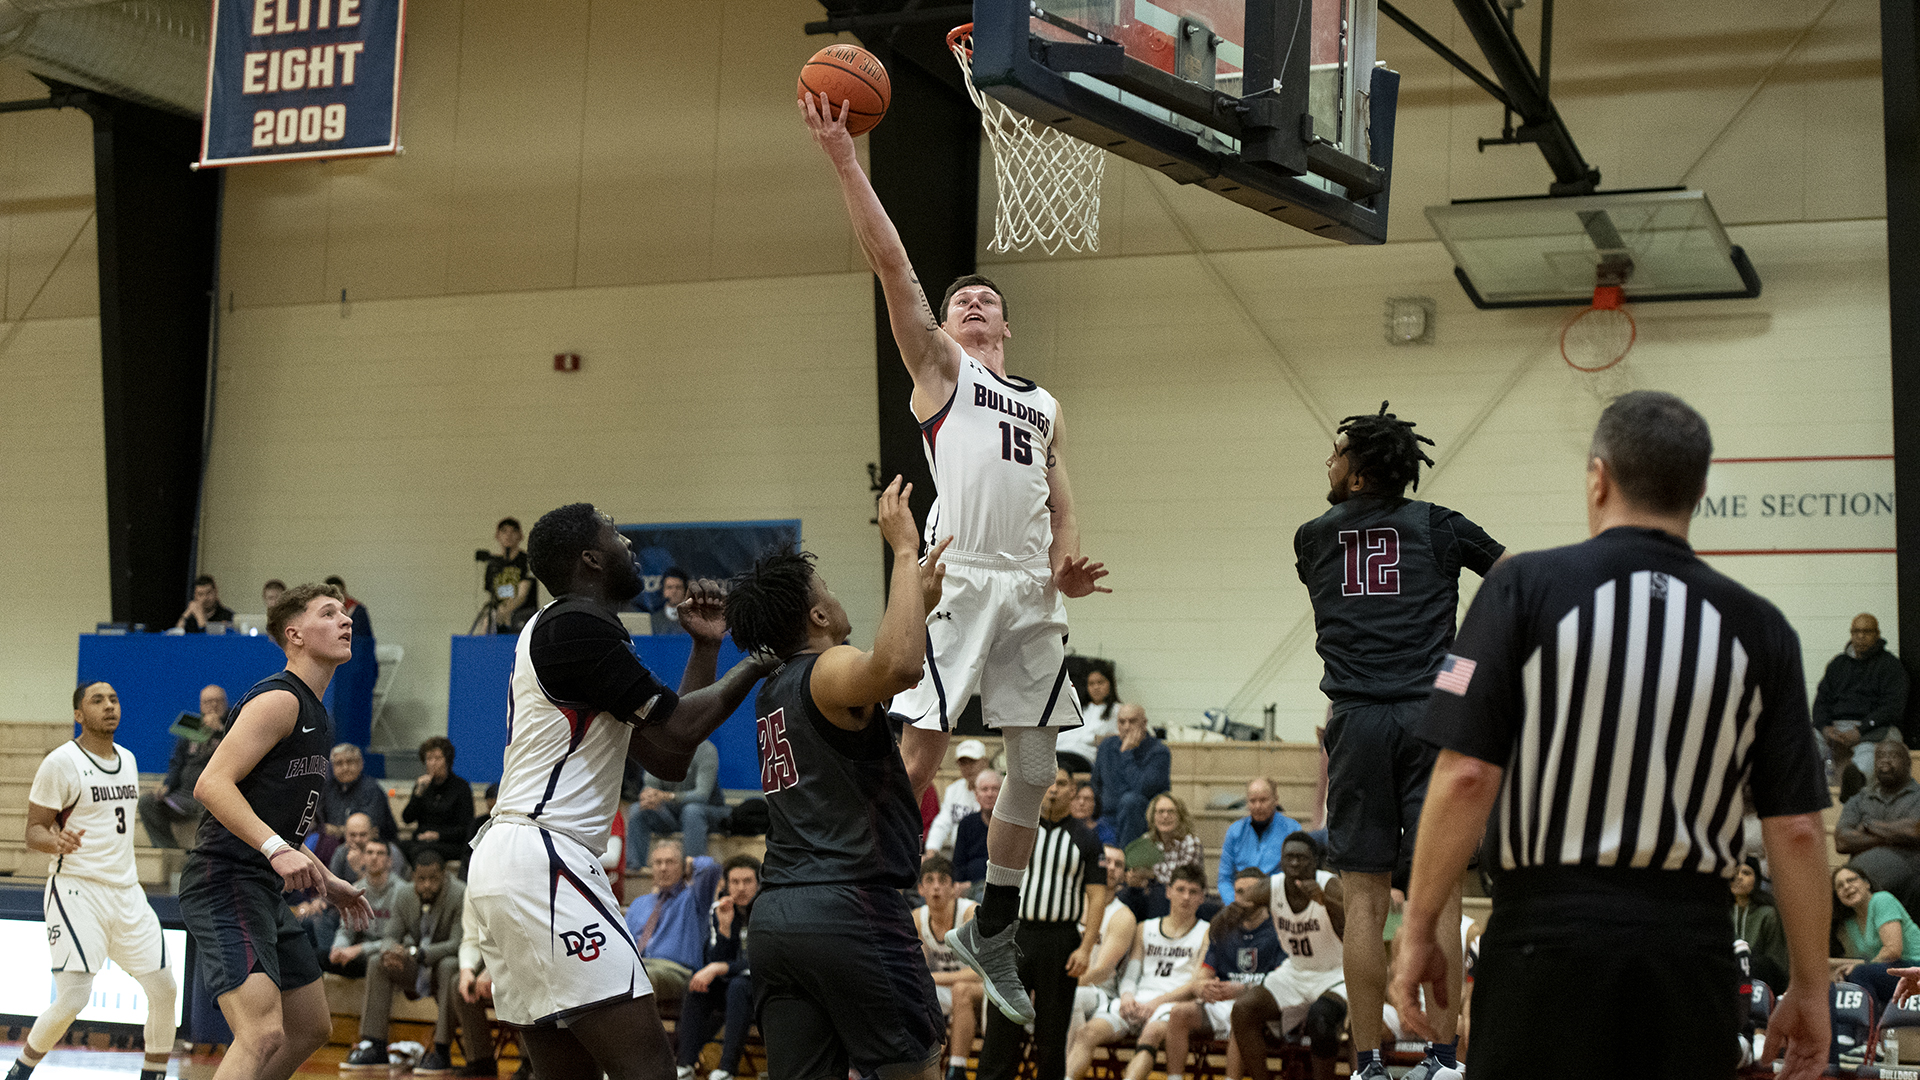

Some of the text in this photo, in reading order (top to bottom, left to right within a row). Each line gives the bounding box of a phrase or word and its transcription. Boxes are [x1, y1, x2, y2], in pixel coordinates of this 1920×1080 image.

[251, 0, 361, 36] ELITE
[242, 41, 365, 95] EIGHT
[252, 103, 347, 148] 2009
[973, 382, 1051, 439] BULLDOGS
[998, 420, 1034, 466] 15
[1760, 492, 1894, 518] SECTION
[1338, 527, 1401, 597] 12
[756, 706, 799, 795] 25
[90, 785, 138, 803] BULLDOGS
[295, 789, 320, 837] 2
[114, 806, 127, 835] 3
